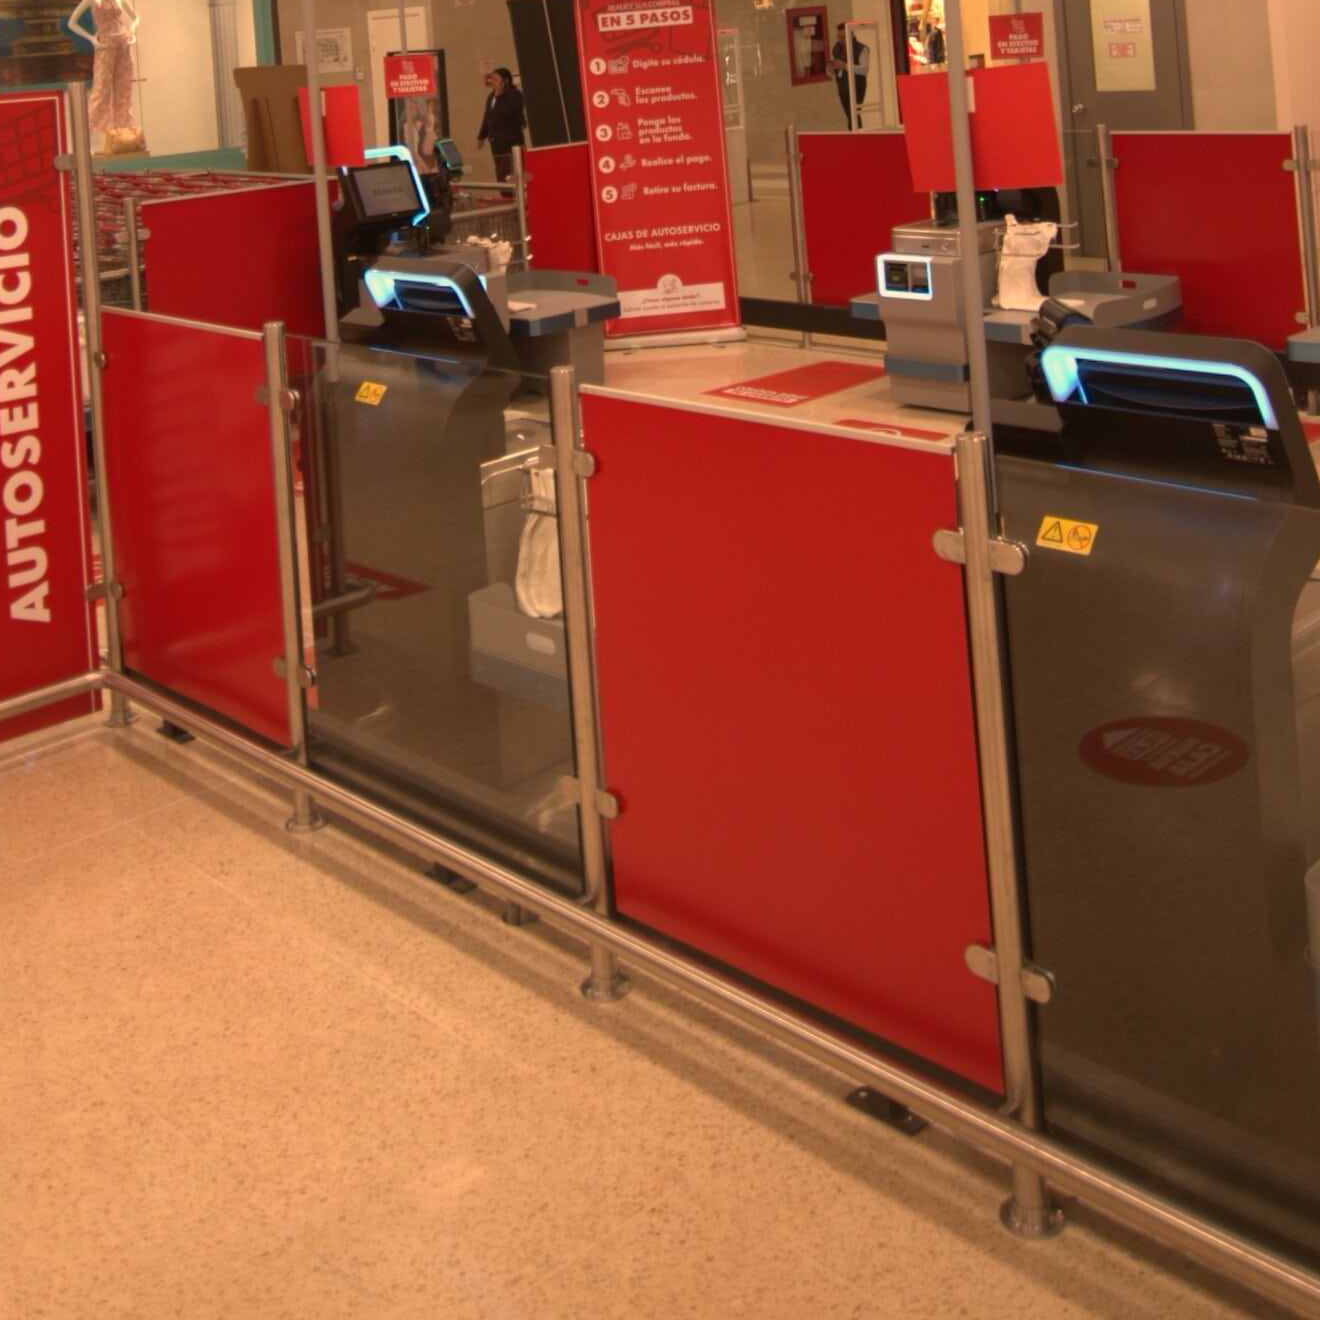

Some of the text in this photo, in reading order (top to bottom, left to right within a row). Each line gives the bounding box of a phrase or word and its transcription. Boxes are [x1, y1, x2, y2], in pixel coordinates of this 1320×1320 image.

[635, 1, 647, 9] SUS
[648, 0, 681, 8] COMPRAS
[601, 9, 691, 28] EN 5 PASOS
[632, 58, 659, 69] Digite
[661, 58, 672, 66] su
[635, 86, 672, 95] Escanee
[636, 93, 698, 105] los productos.
[637, 118, 666, 128] Ponga
[667, 116, 681, 124] los
[638, 125, 682, 137] productos
[639, 137, 651, 145] en
[652, 135, 662, 143] la
[641, 157, 674, 167] Realice
[675, 156, 685, 165] el
[643, 185, 670, 196] Retire
[671, 185, 682, 193] su
[604, 223, 721, 242] CAJAS DE AUTOSERVICIO
